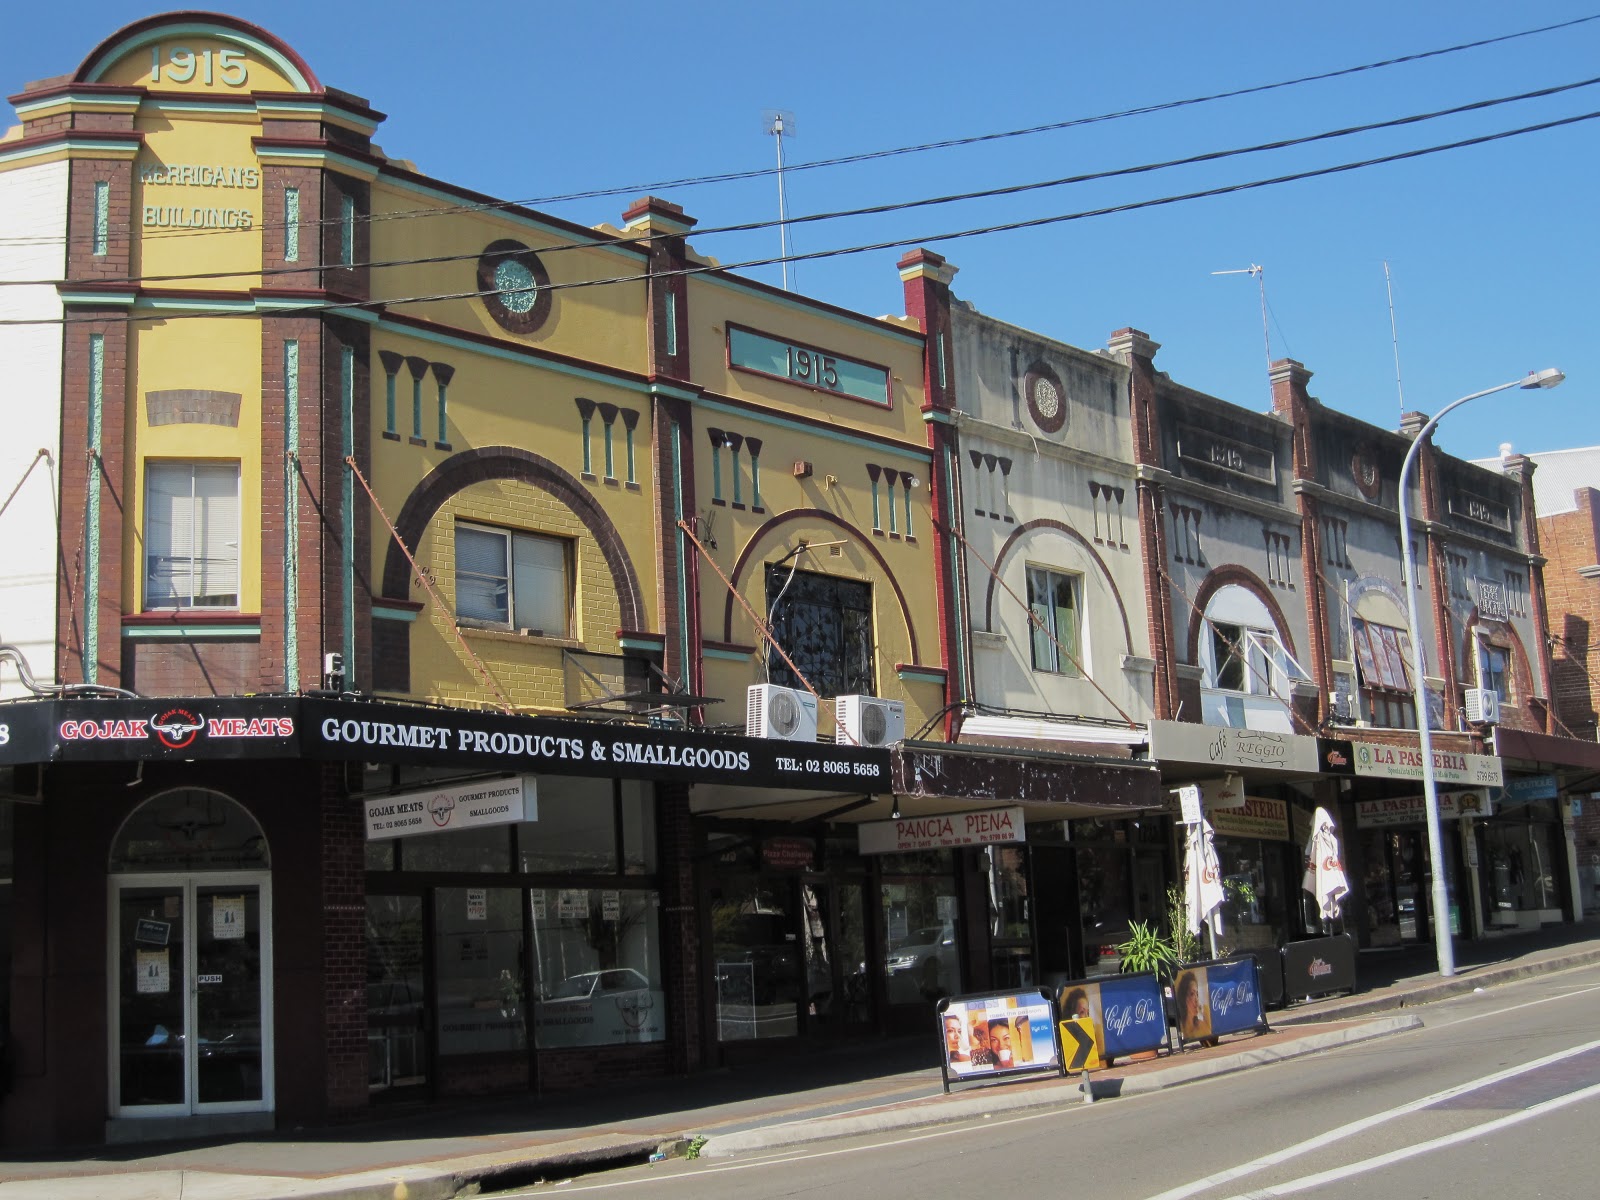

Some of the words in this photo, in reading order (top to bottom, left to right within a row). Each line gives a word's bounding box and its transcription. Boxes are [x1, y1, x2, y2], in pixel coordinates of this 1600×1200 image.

[152, 46, 248, 85] 1915
[143, 205, 252, 228] BUILDINGS
[786, 347, 838, 388] 1915
[1211, 445, 1243, 470] 1915
[158, 709, 177, 726] GOJAK
[178, 709, 197, 725] MEATS
[60, 719, 149, 740] GOJAK
[208, 718, 294, 738] MEATS
[321, 718, 451, 750] GOURMET
[458, 729, 584, 760] PRODUCTS
[591, 741, 606, 761] &
[613, 741, 750, 771] SMALLGOODS
[1209, 729, 1228, 761] Café
[1236, 742, 1285, 758] REGGIO
[776, 757, 802, 772] TEL:
[806, 760, 820, 773] 02
[823, 761, 850, 774] 8065
[853, 763, 880, 776] 5658
[1374, 748, 1396, 765] LA
[1398, 751, 1468, 770] PASERIA
[459, 792, 487, 803] GOURMET
[488, 787, 520, 798] PRODUCTS
[1360, 802, 1380, 814] LA
[1383, 795, 1453, 812] PASTEIA
[369, 806, 395, 818] GOJAK
[397, 802, 424, 814] MEATS
[470, 805, 510, 817] SMALLGOODS
[373, 823, 386, 831] TEL:
[386, 821, 393, 829] 02
[896, 818, 953, 840] PANCIA
[965, 811, 1013, 834] PIENA
